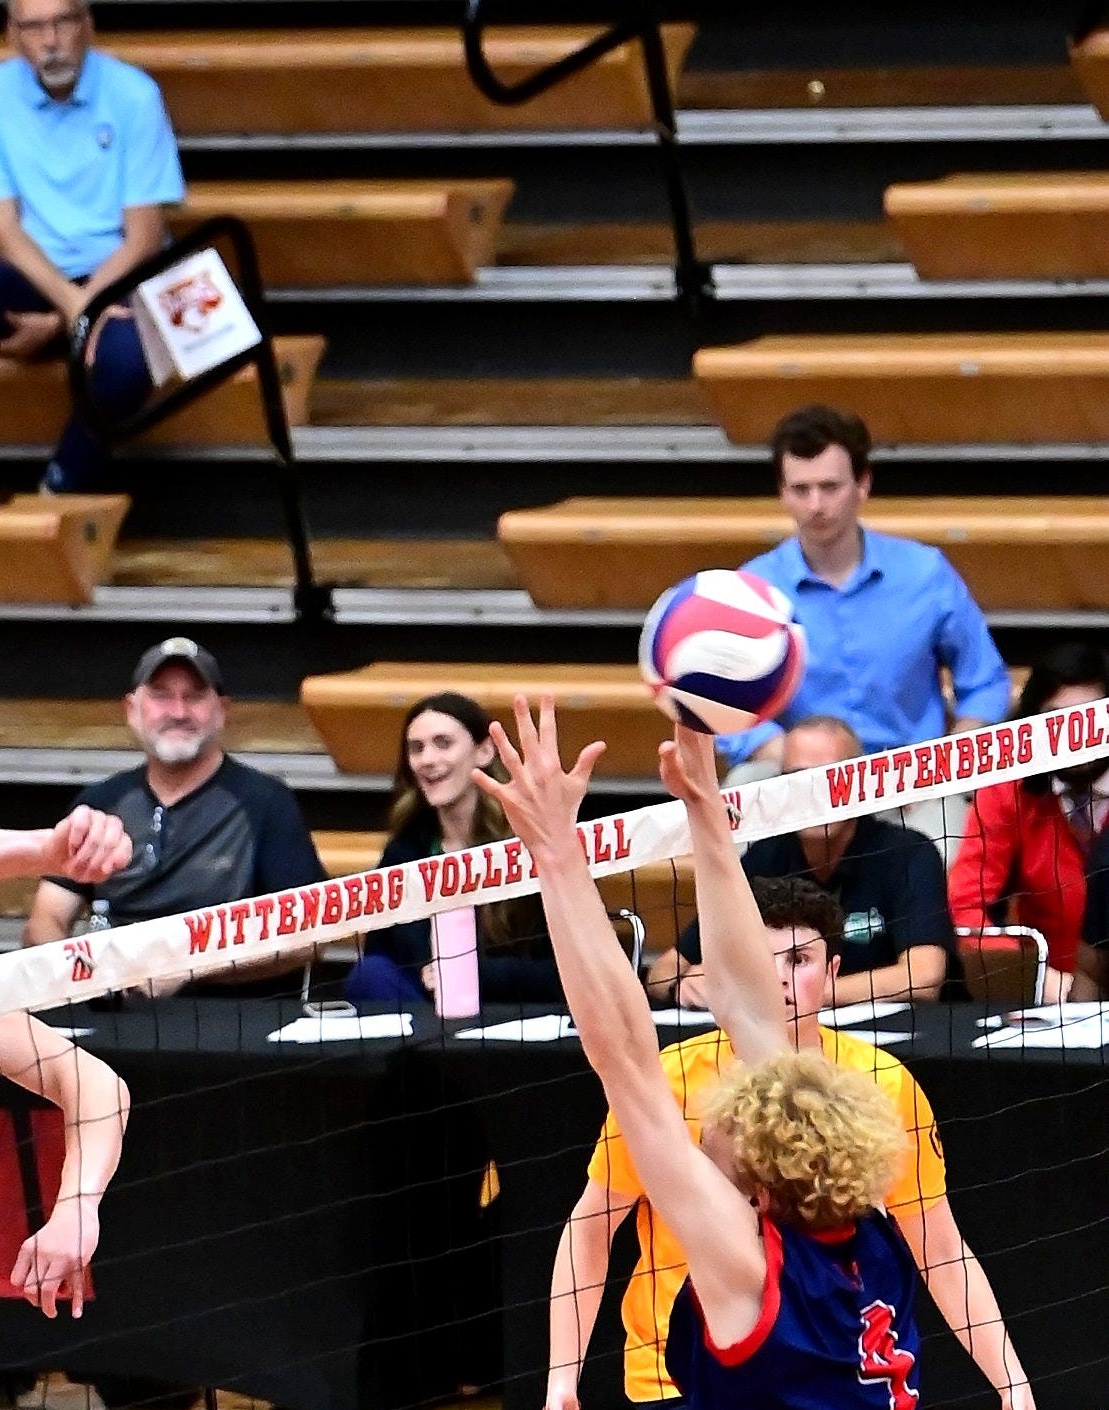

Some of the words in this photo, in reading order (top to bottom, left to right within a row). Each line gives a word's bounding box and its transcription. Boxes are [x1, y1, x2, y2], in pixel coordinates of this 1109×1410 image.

[826, 722, 1033, 809] WITTENBERG
[1045, 703, 1109, 757] VOL
[184, 868, 404, 955] WITTENBERG
[419, 817, 632, 902] VOLLELL
